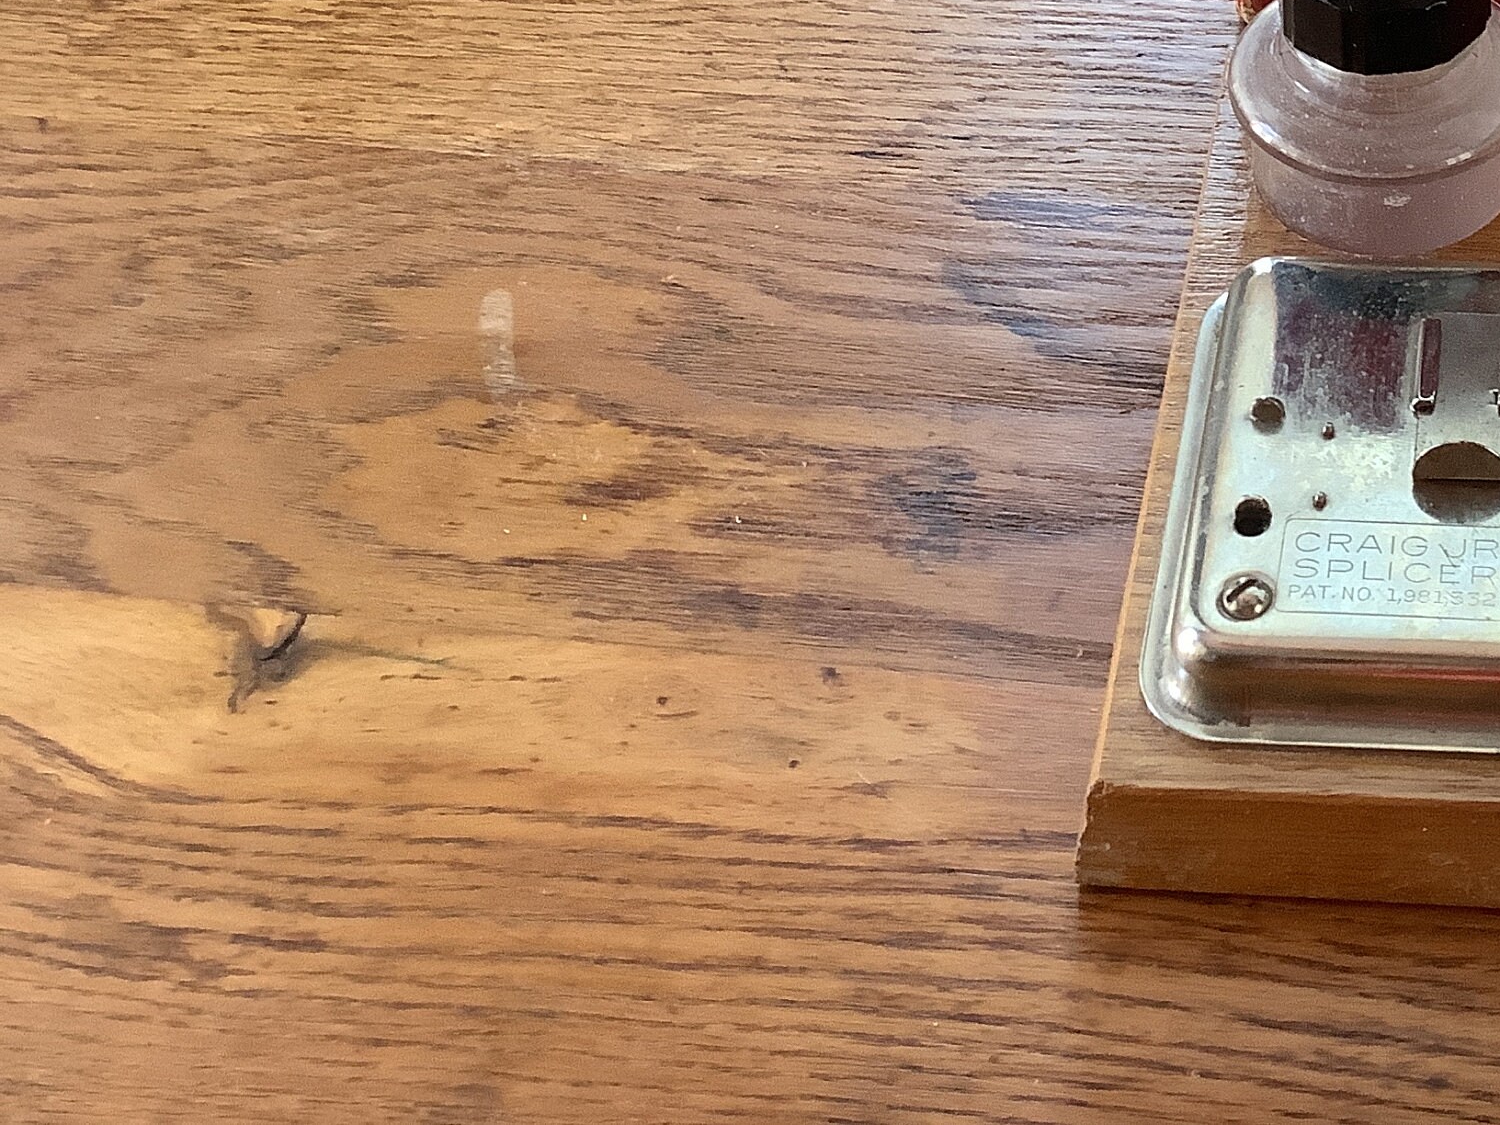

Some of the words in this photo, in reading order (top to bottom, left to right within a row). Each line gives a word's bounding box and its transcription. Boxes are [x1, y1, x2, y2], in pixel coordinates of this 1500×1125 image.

[1295, 531, 1428, 557] CRAIG
[1293, 558, 1498, 586] SPLICER
[1288, 584, 1336, 600] PAT.
